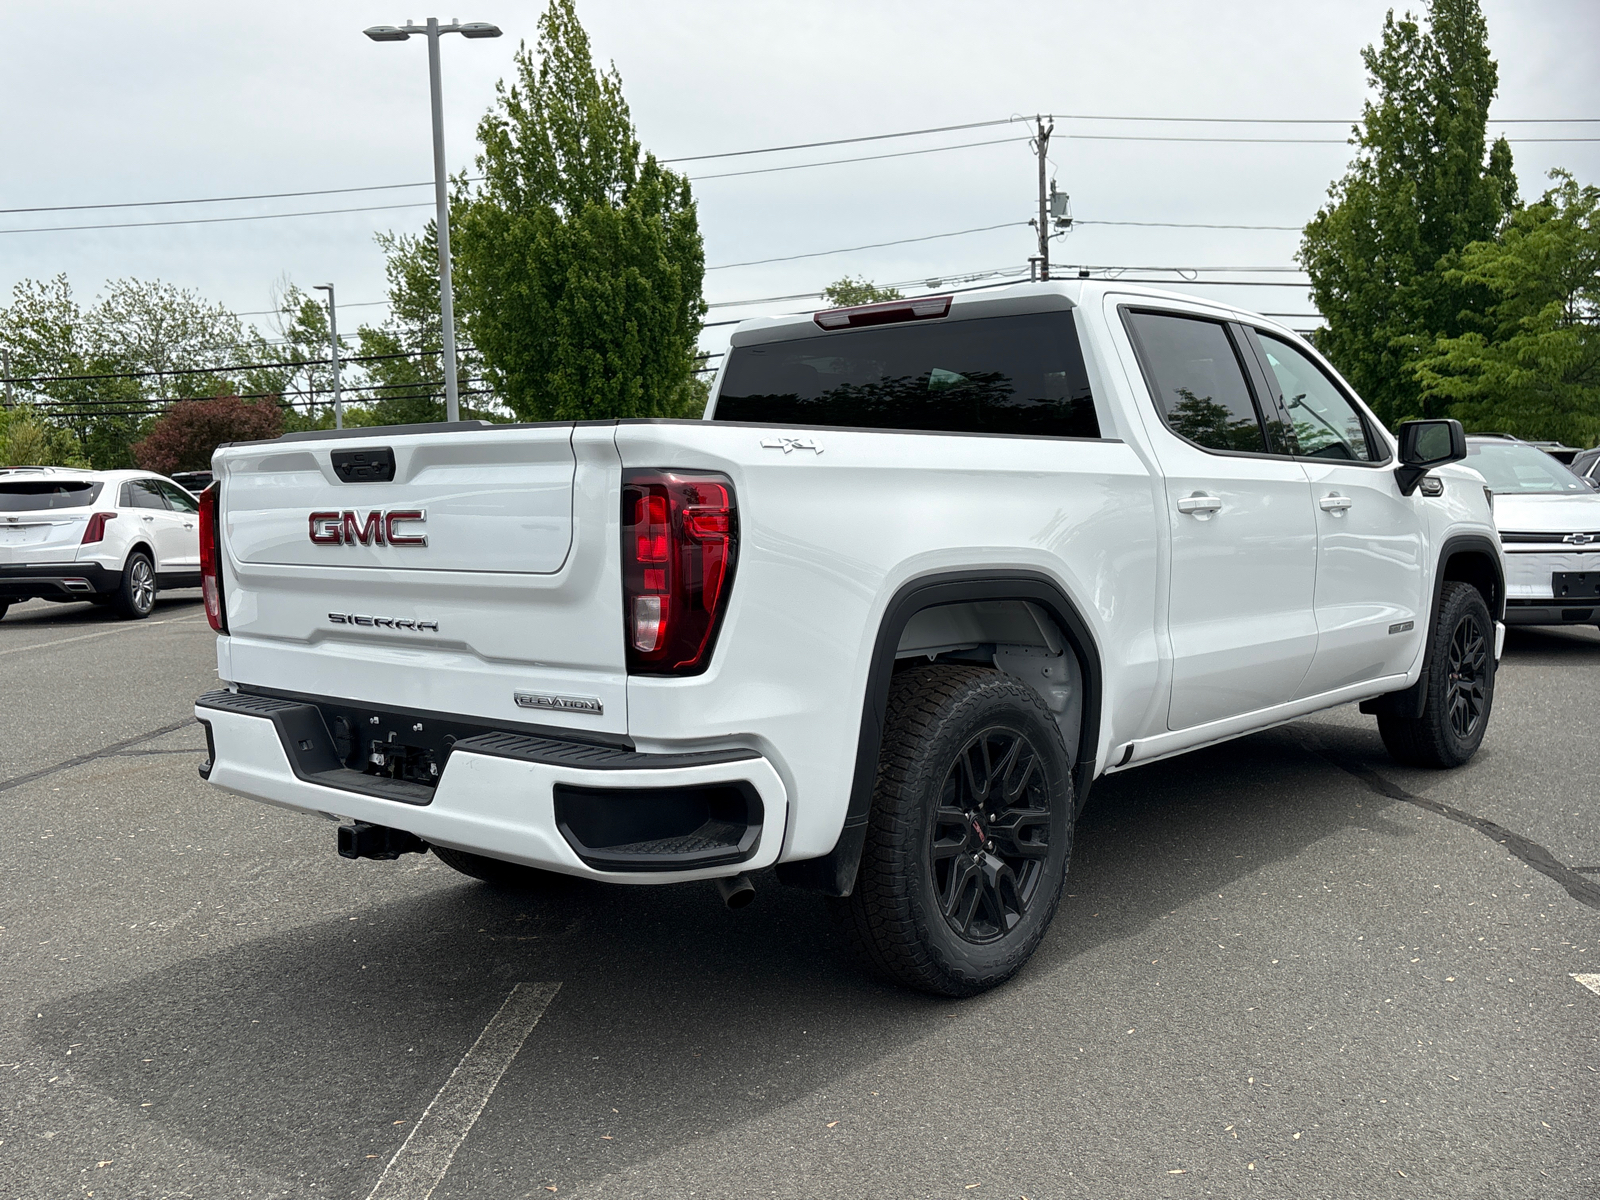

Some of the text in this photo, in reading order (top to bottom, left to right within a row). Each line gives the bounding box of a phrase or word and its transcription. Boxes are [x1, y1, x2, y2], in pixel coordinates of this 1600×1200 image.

[308, 509, 428, 548] GMC
[327, 611, 439, 632] SIERRA
[520, 695, 597, 710] ELEVATION
